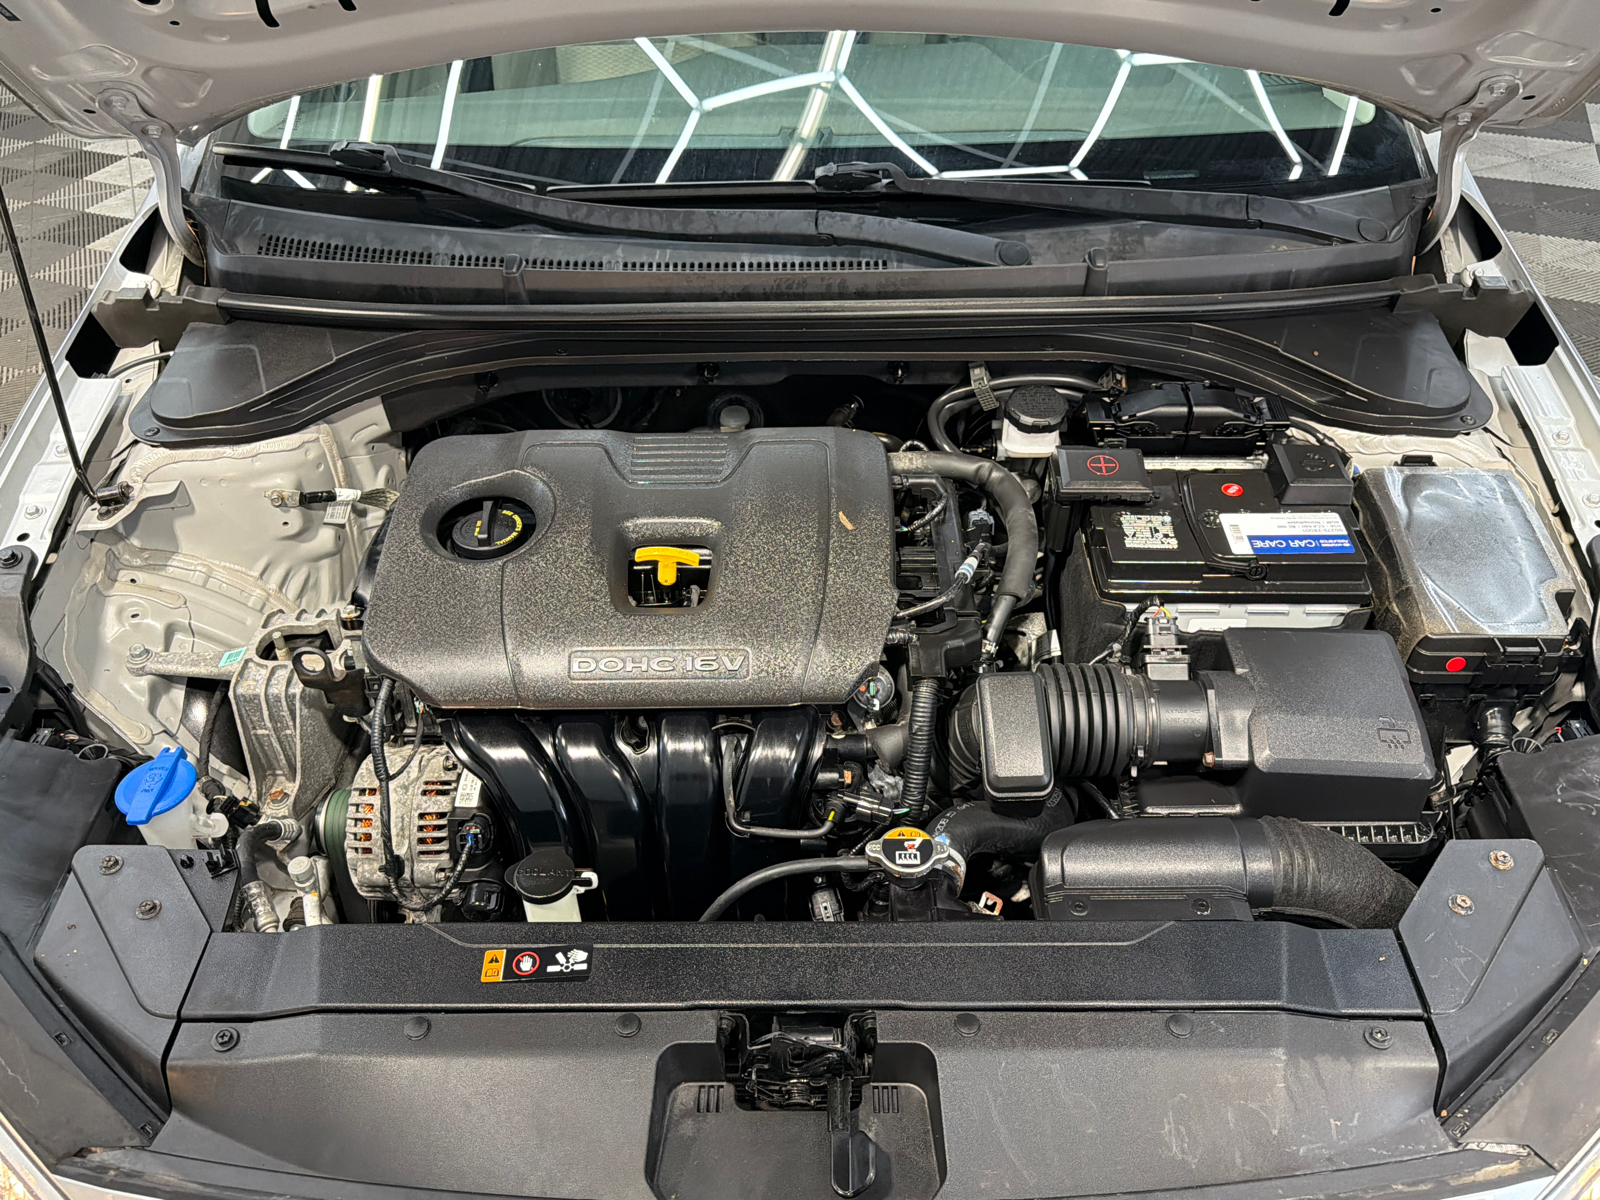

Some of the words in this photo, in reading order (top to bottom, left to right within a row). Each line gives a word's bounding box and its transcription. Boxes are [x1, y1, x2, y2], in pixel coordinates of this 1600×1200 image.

[495, 532, 519, 546] MANUAL
[1250, 539, 1287, 548] CARE
[1288, 539, 1316, 548] CAR
[572, 656, 675, 673] DOHC
[685, 655, 747, 672] 16V
[517, 867, 574, 877] COOLANT
